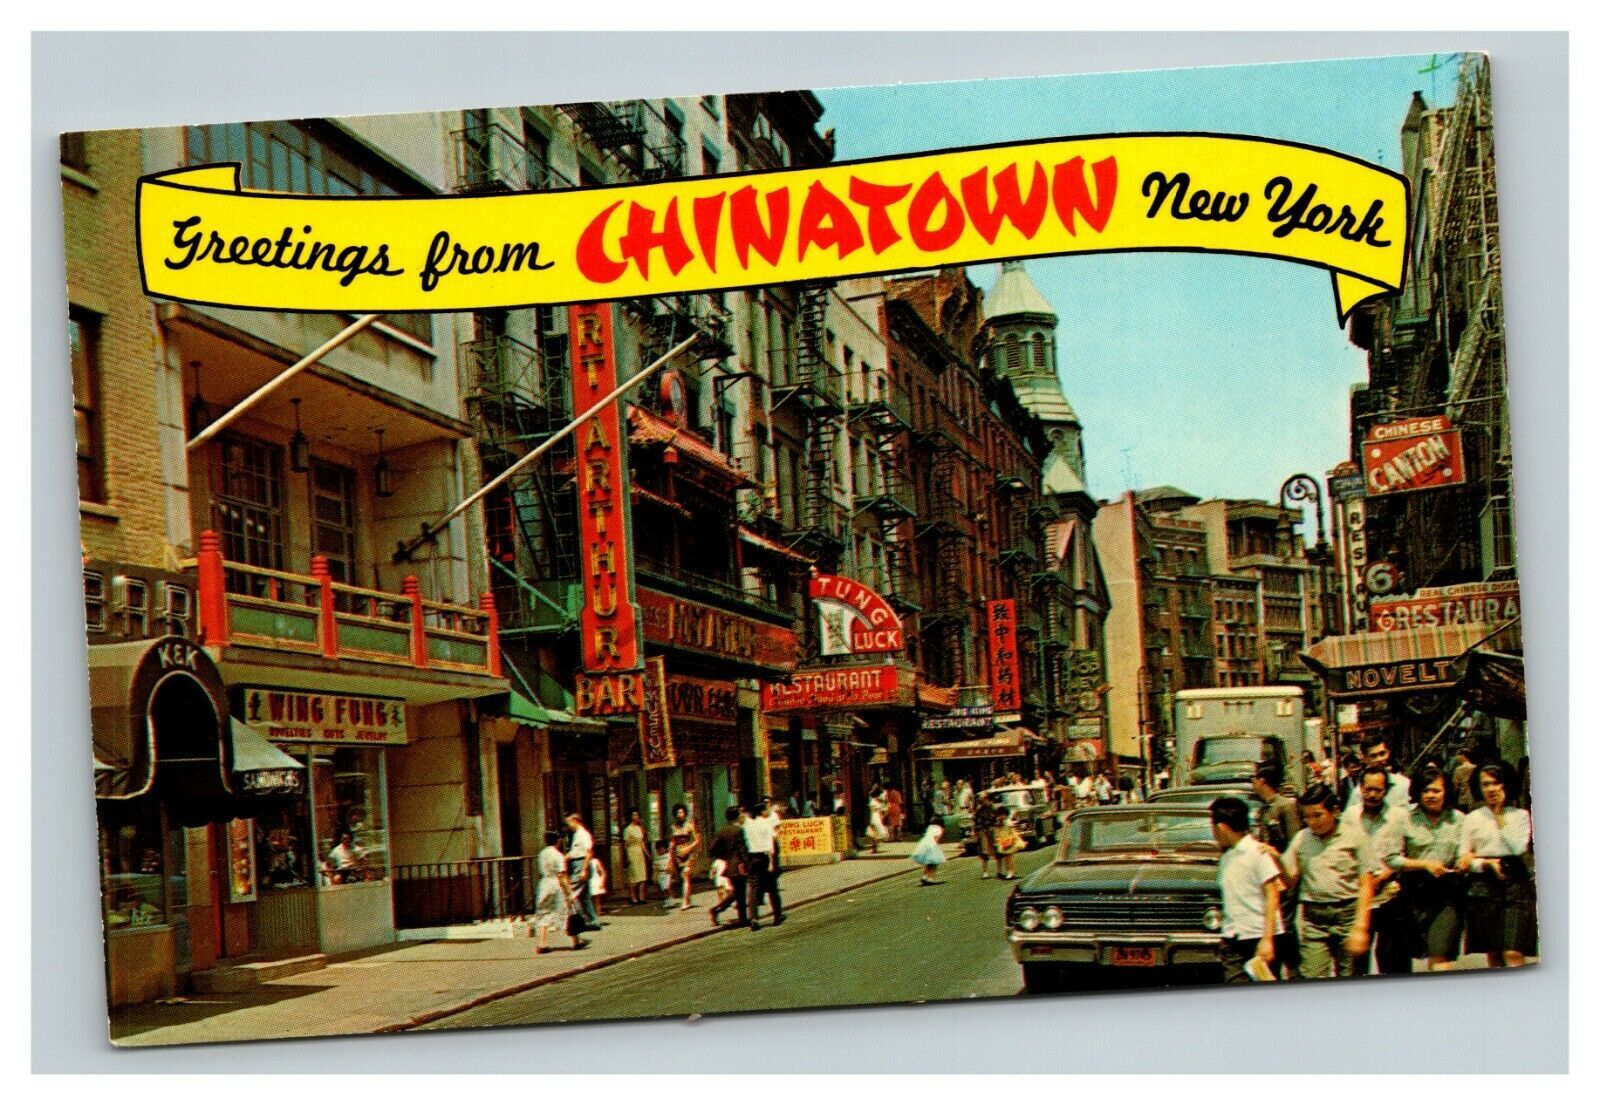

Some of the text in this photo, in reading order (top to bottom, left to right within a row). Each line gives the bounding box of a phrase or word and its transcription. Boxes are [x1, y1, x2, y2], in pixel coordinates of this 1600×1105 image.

[164, 155, 1392, 292] Greetings from CHINATOWN New York
[1373, 419, 1443, 440] CHINESE
[1368, 434, 1450, 493] CANTON
[585, 416, 622, 662] ARTHUR
[1366, 563, 1393, 593] 6
[817, 577, 888, 625] TUNG
[854, 631, 898, 650] LUCK
[267, 691, 387, 726] WING FUNG
[576, 673, 637, 714] BAR
